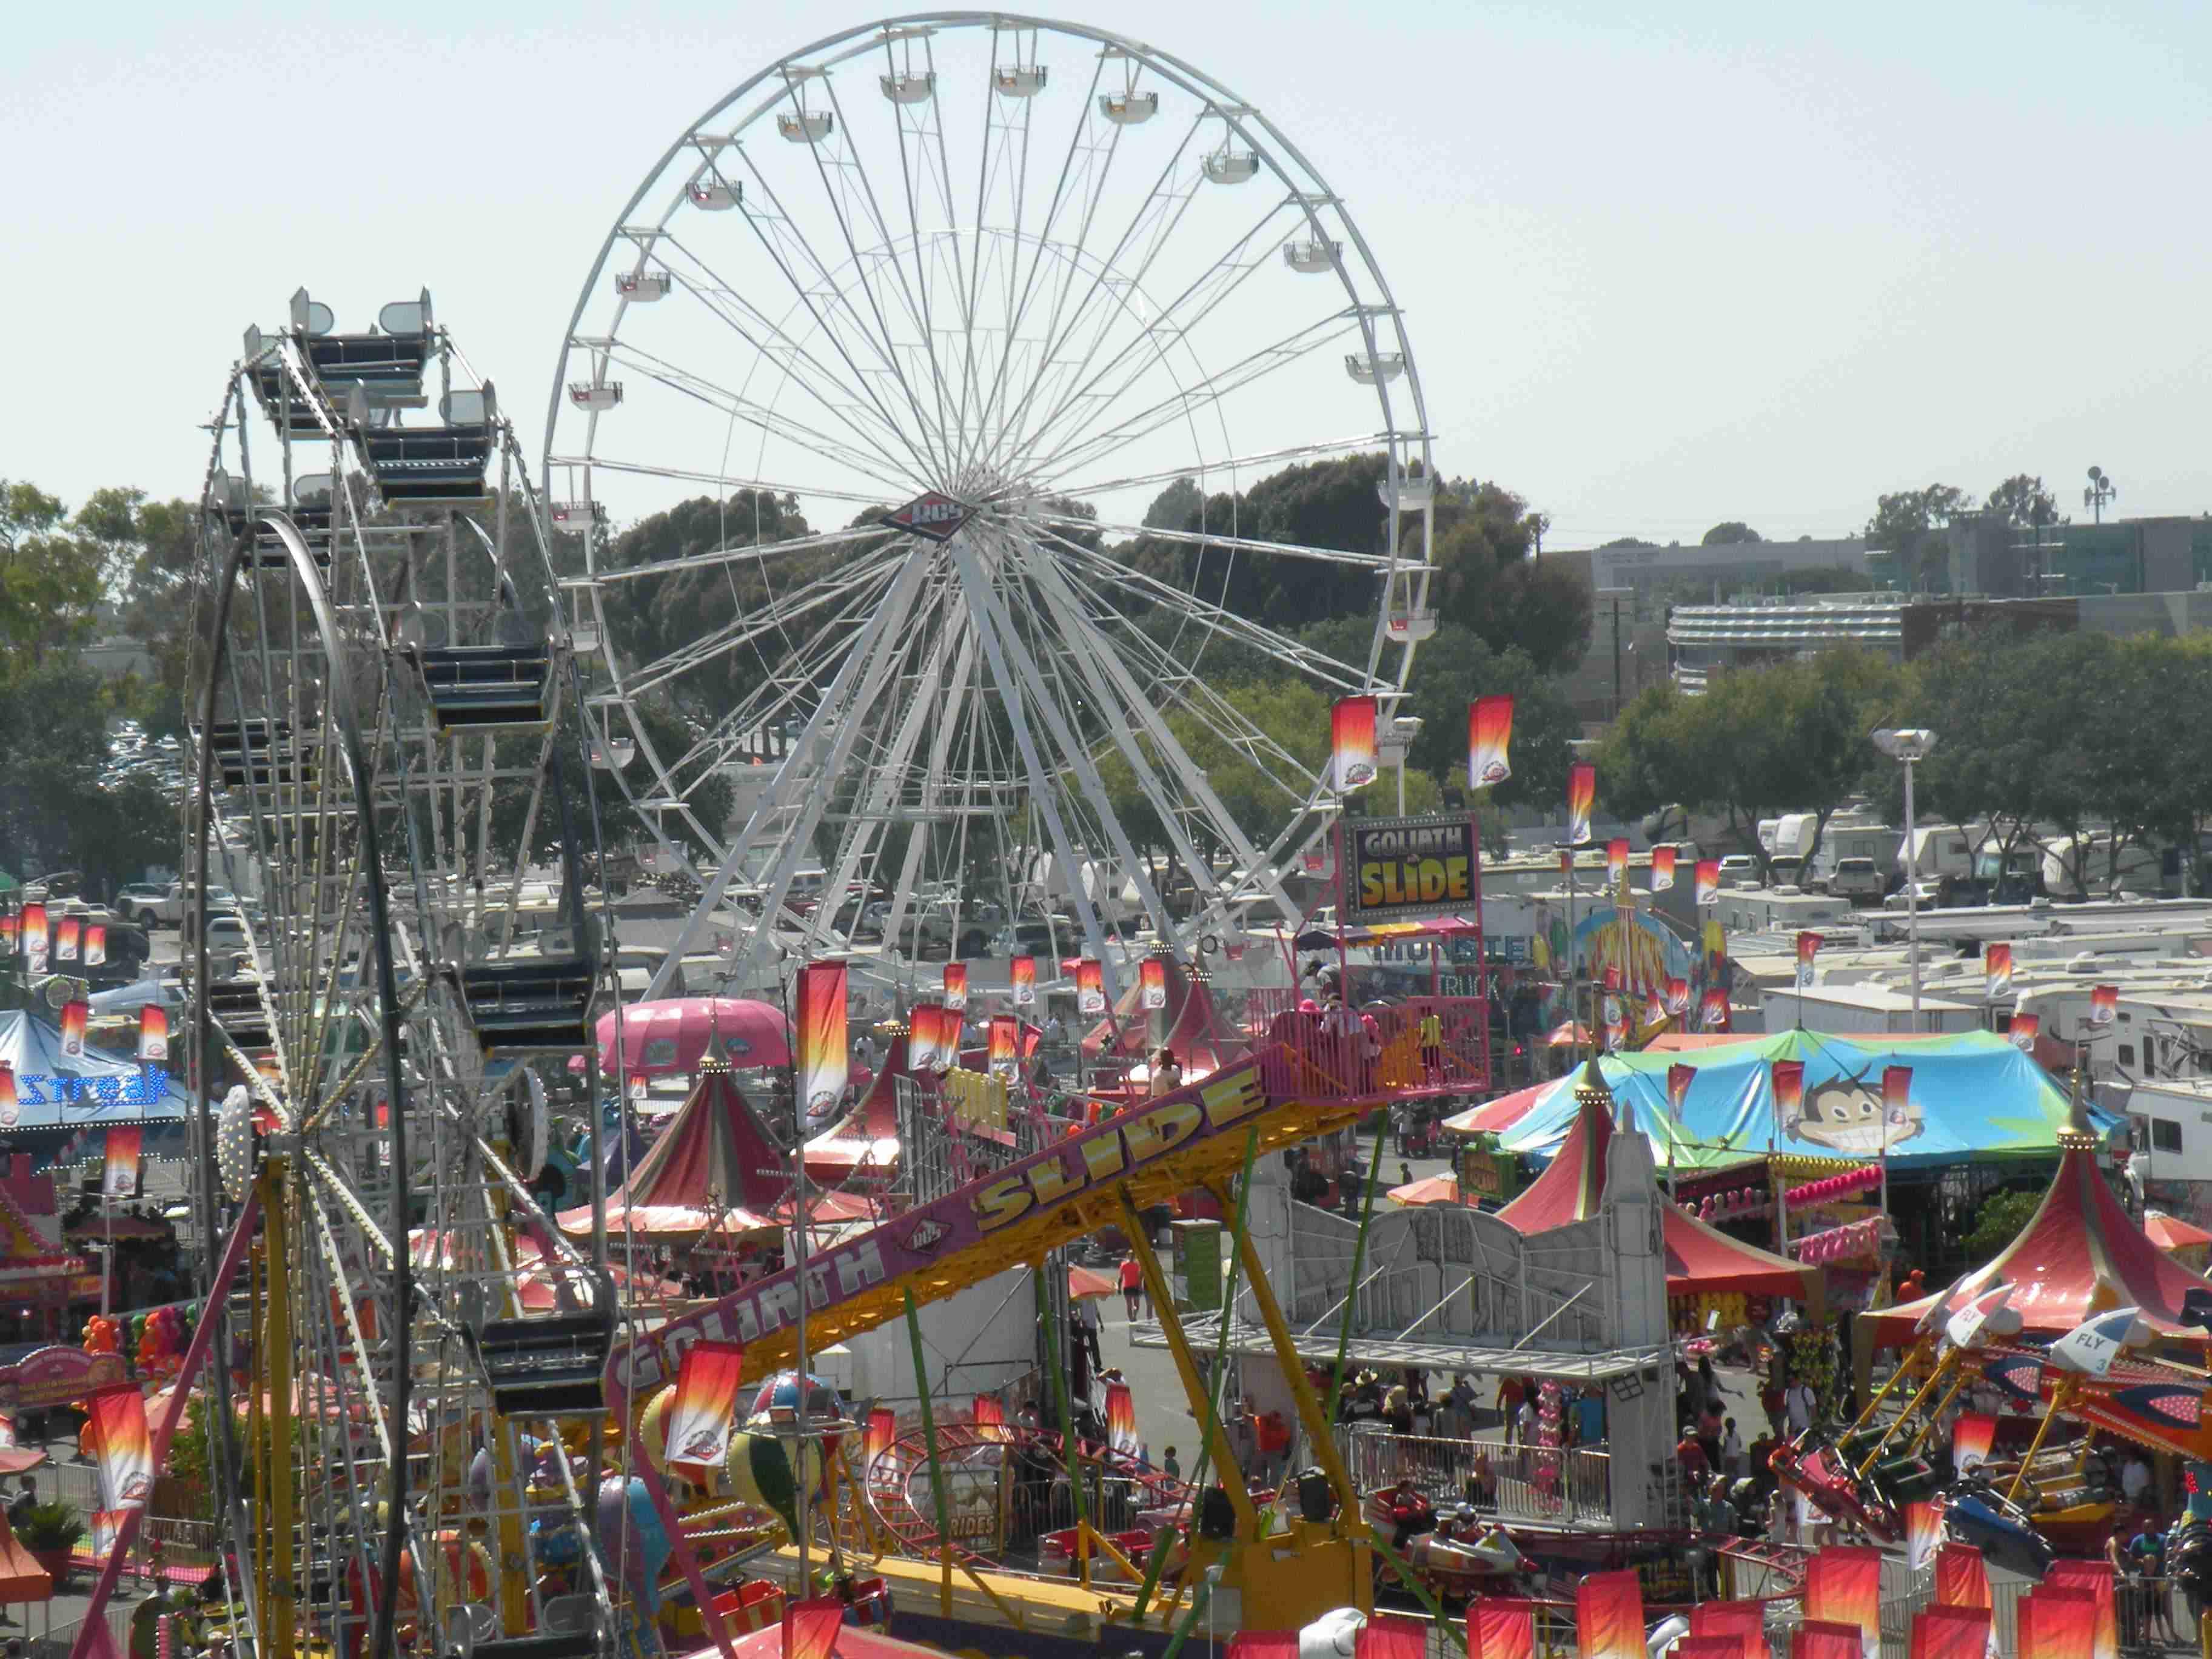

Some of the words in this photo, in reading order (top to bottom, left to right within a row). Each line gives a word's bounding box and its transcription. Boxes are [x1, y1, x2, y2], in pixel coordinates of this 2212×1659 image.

[1365, 826, 1463, 857] GOLIATH
[971, 1065, 1262, 1232] SLIDE
[2076, 1332, 2106, 1350] FLY
[2096, 1358, 2107, 1372] 3
